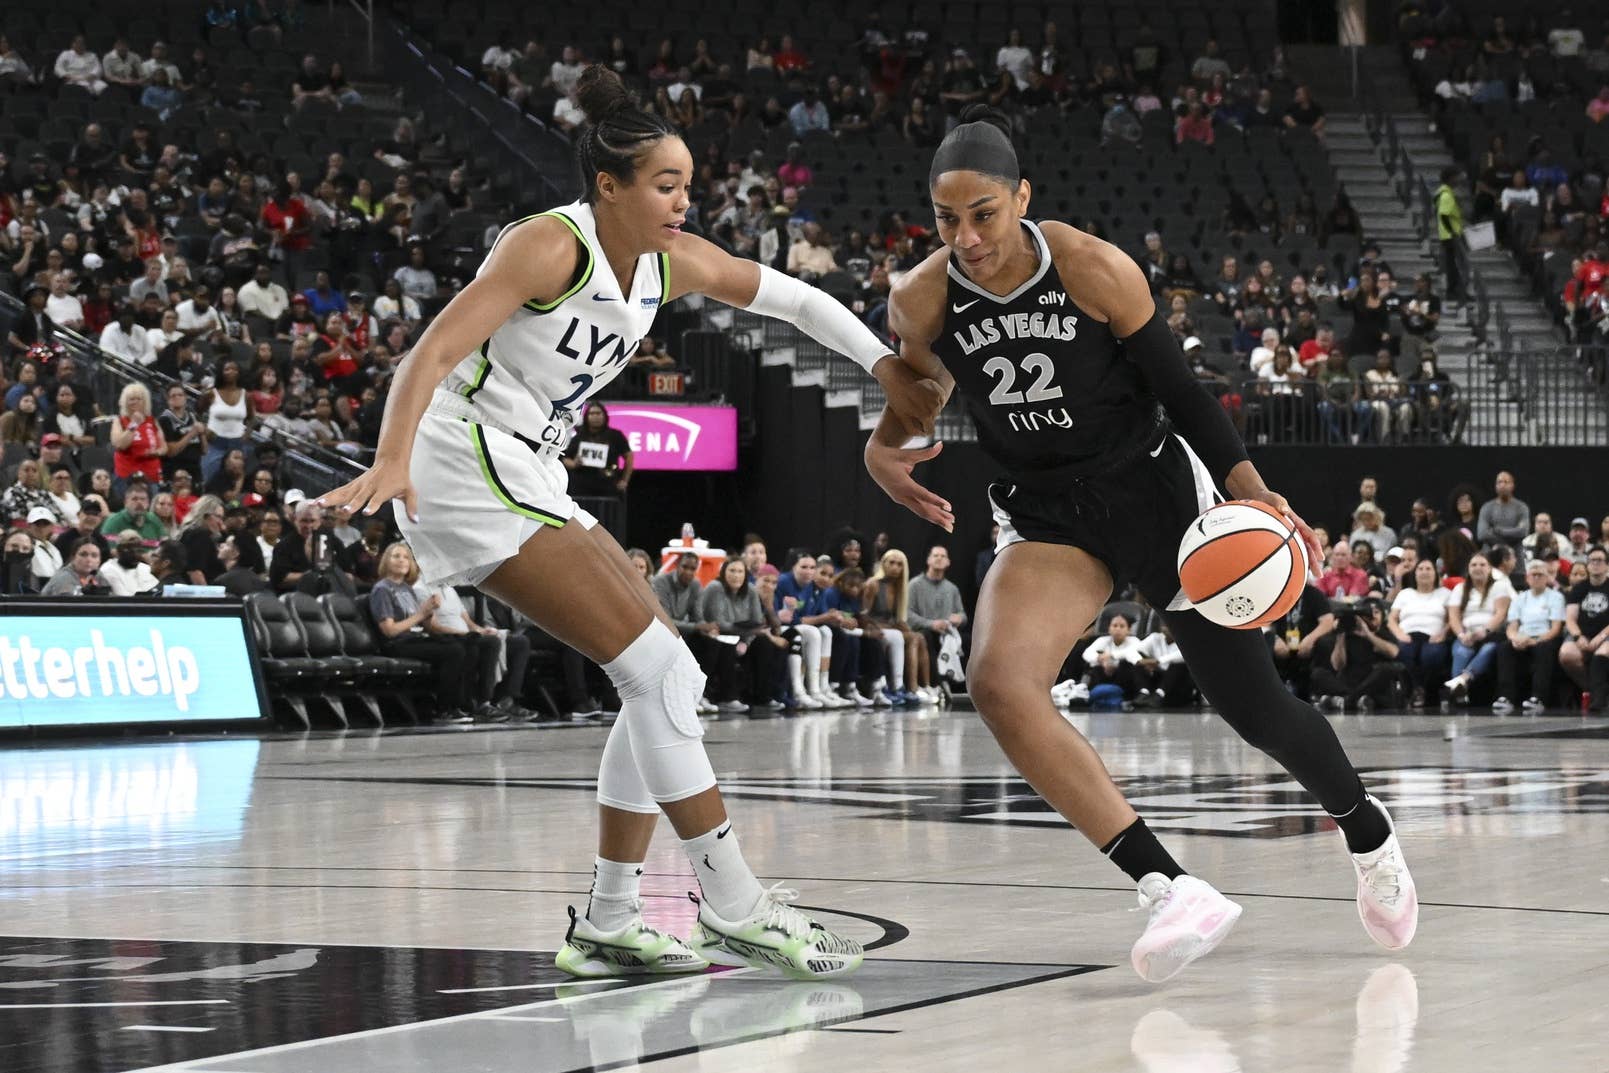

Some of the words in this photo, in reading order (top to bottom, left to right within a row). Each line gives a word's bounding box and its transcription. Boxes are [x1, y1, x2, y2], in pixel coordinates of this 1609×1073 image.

[1038, 291, 1066, 306] ally
[555, 317, 638, 368] LYN
[954, 318, 1001, 355] LAS
[998, 312, 1078, 341] VEGAS
[656, 373, 680, 394] EXIT
[982, 352, 1063, 405] 22
[1008, 408, 1073, 432] ring
[628, 431, 681, 453] ENA
[0, 629, 200, 711] tterhelp
